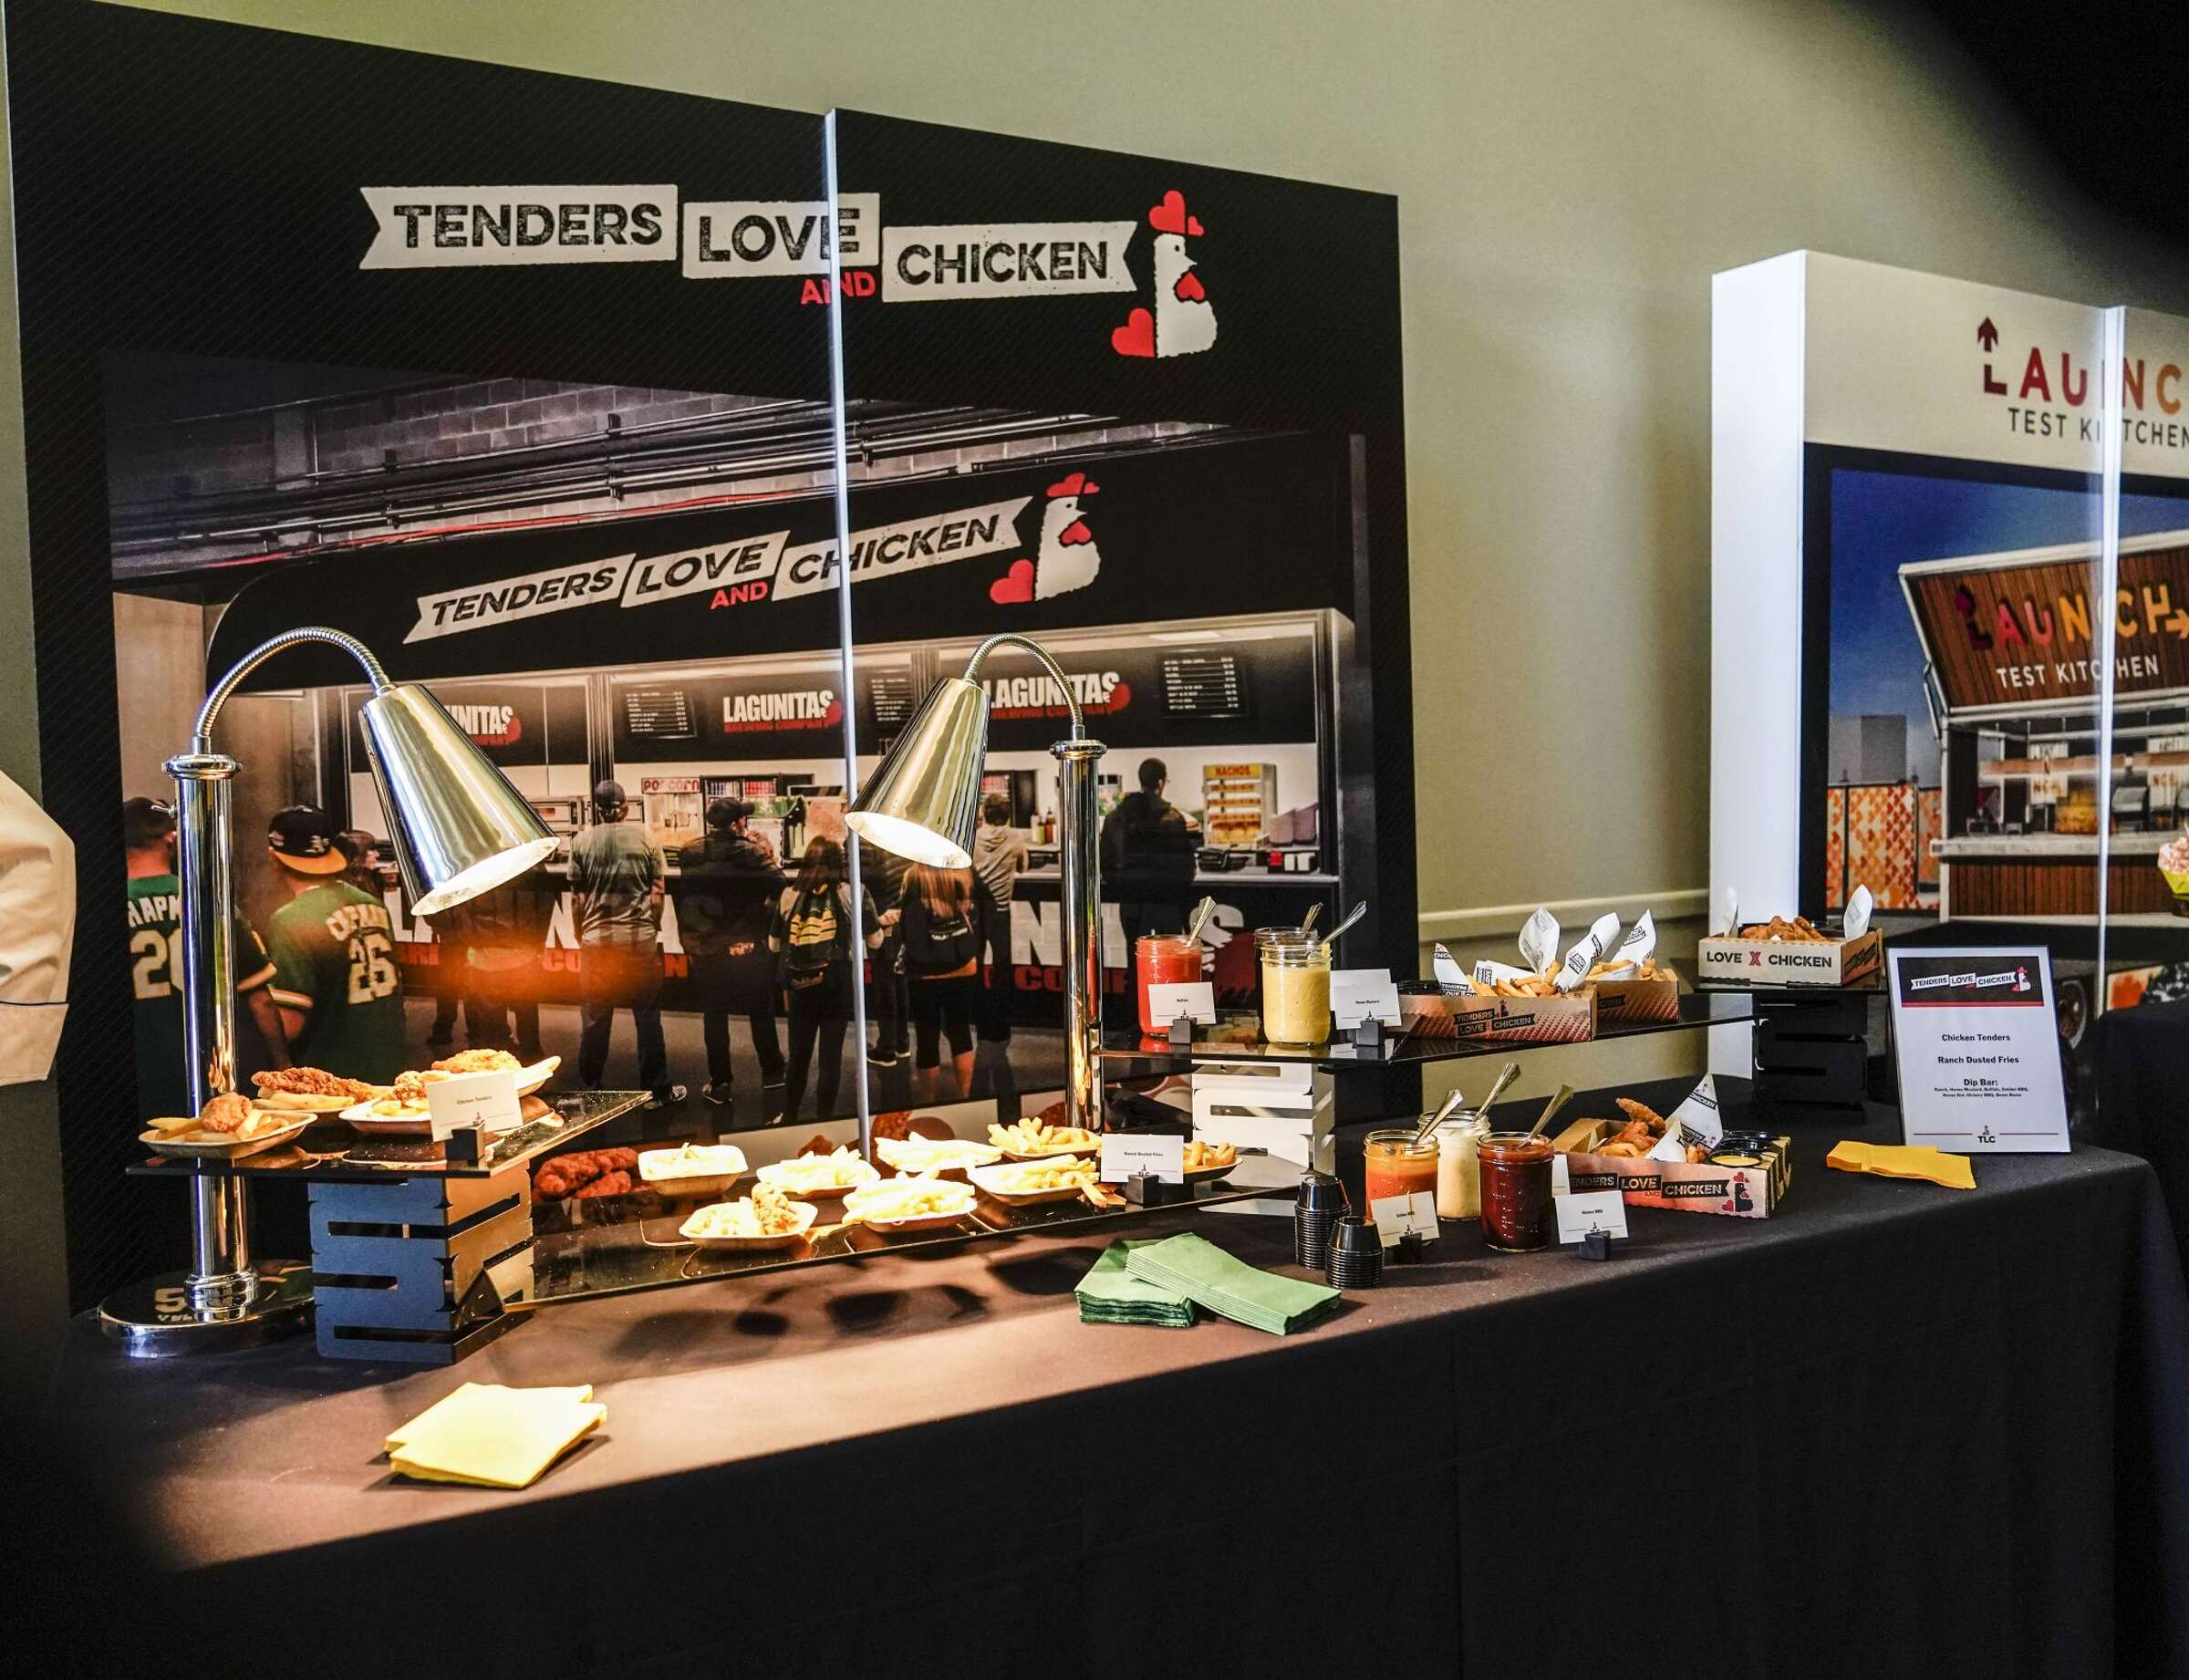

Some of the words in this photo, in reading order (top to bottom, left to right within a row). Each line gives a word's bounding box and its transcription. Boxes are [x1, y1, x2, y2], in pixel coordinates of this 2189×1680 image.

[394, 203, 662, 248] TENDERS
[700, 208, 860, 263] LOVE
[897, 241, 1107, 285] CHICKEN
[800, 272, 876, 305] AND
[1984, 346, 2183, 415] LAUNC
[2007, 407, 2068, 439] TEST
[432, 566, 617, 626] TENDERS
[636, 542, 769, 596] LOVE
[789, 513, 1000, 585] CHICKEN
[710, 581, 768, 610] AND
[1966, 584, 2172, 650] LAUNCH
[1997, 664, 2046, 689] TEST
[2057, 654, 2160, 683] KITCHEN
[723, 690, 834, 723] LAGUNITAS
[982, 671, 1120, 709] LAGUNTAS
[1707, 951, 1742, 963] LOVE
[1769, 954, 1832, 968] CHICKEN
[1914, 977, 1947, 987] TENDERS
[1952, 976, 1974, 984] LOVE
[1977, 975, 2011, 985] CHICKEN
[1458, 1010, 1494, 1022] TENDERS
[1461, 1023, 1484, 1033] LOVE
[1493, 1017, 1532, 1031] CHICKEN
[1571, 1177, 1614, 1187] ENDERS
[1622, 1177, 1657, 1189] LOVE
[1665, 1184, 1722, 1197] CHICKEN
